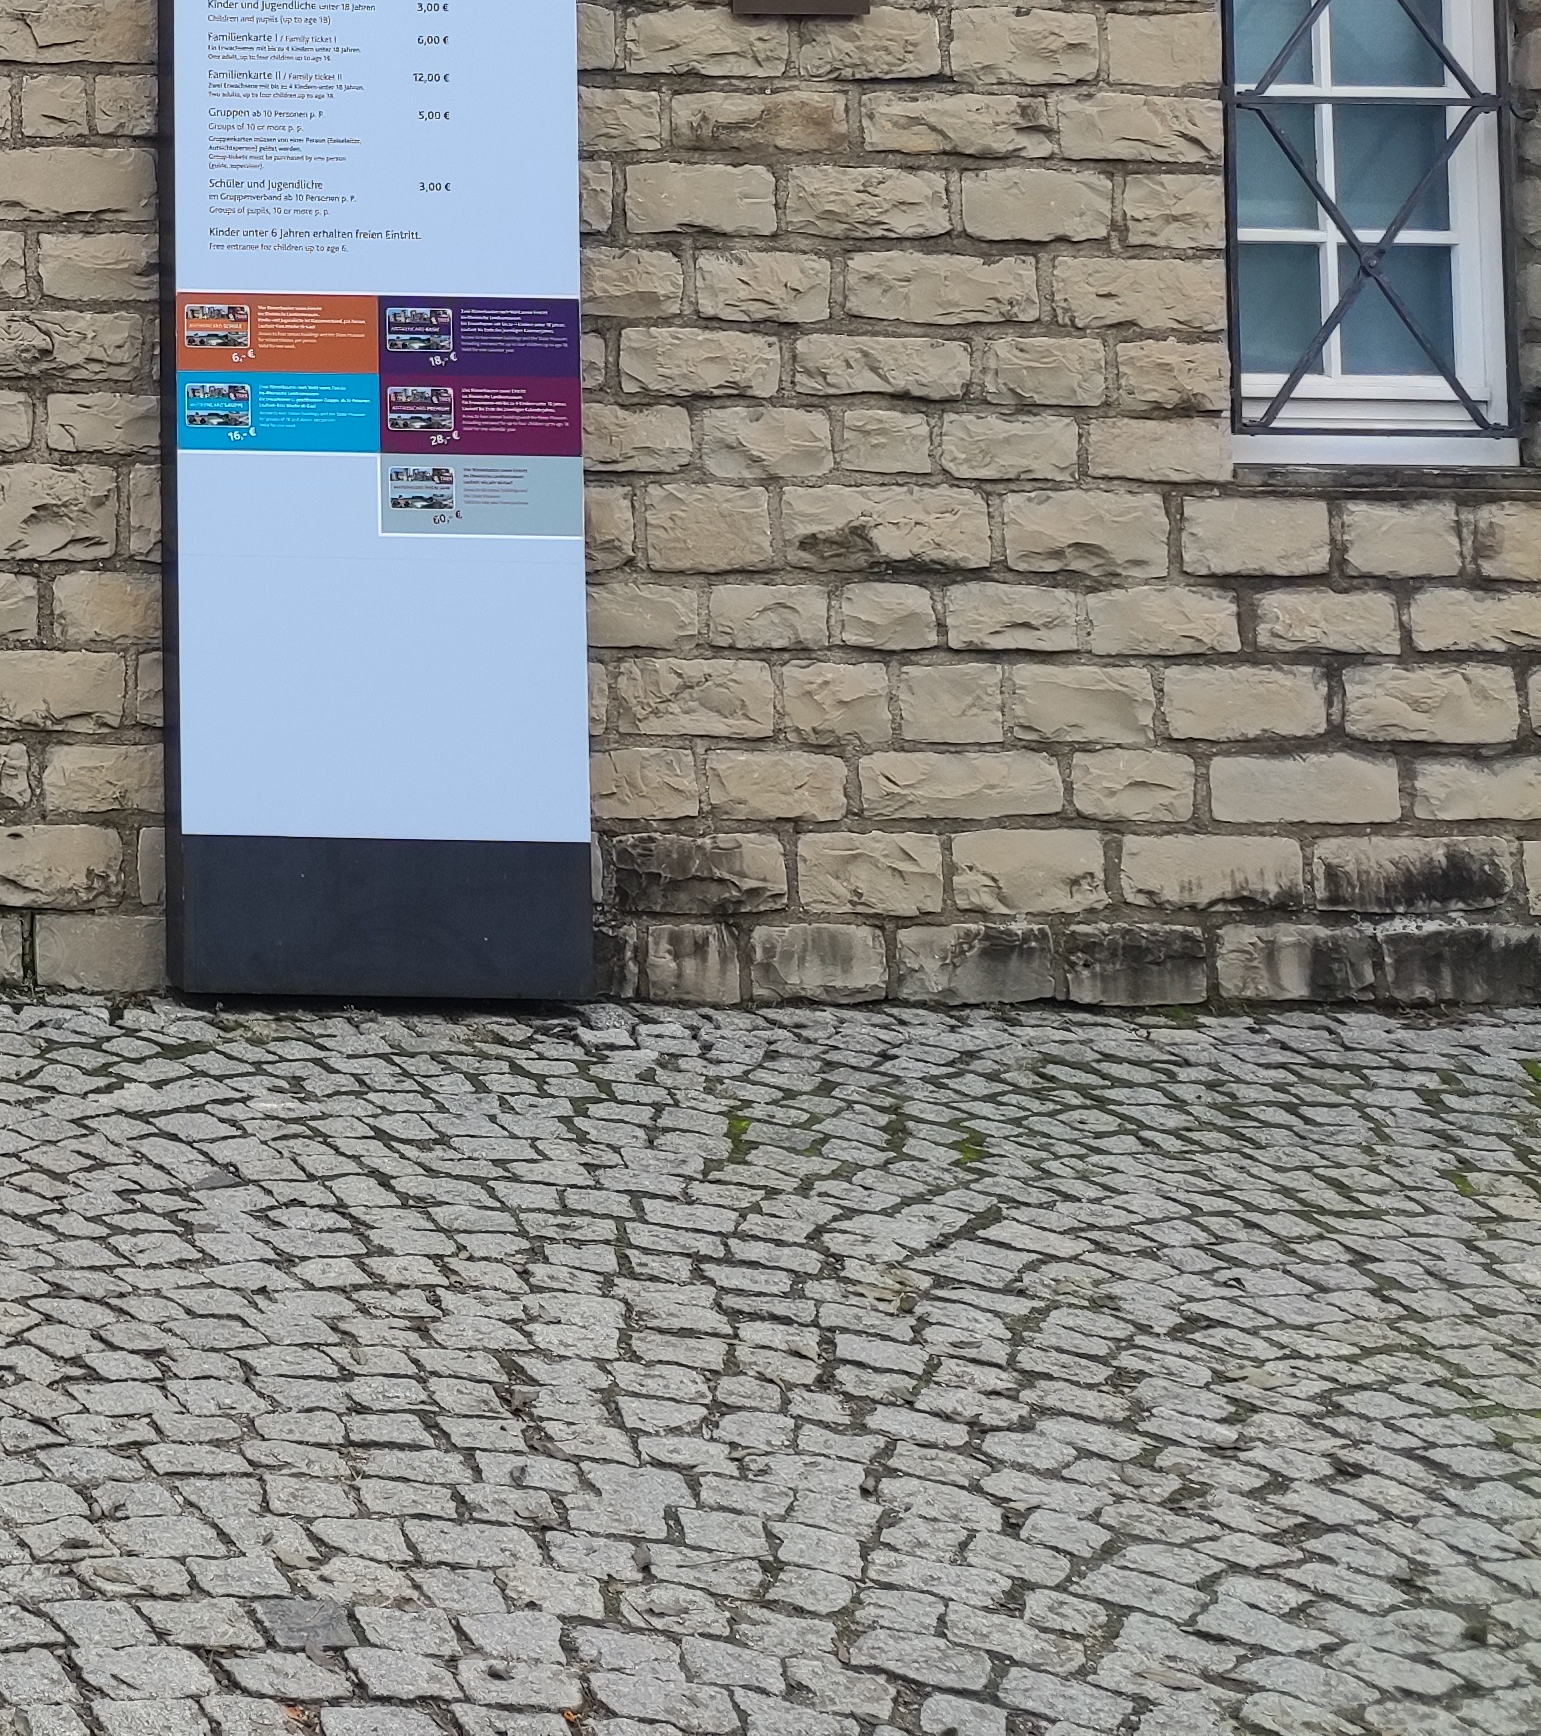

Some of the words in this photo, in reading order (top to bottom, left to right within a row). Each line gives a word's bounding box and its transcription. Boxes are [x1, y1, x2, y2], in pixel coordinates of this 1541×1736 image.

[207, 0, 239, 9] Kinder
[240, 0, 259, 9] und
[260, 0, 316, 12] Jugendliche
[416, 2, 440, 13] 3,00
[442, 3, 449, 12] €
[240, 15, 254, 23] and
[207, 32, 273, 42] Familienkarte
[208, 70, 273, 80] Familienkarte
[412, 73, 441, 84] 12,00
[443, 73, 450, 82] €
[208, 107, 250, 119] Gruppen
[263, 110, 273, 118] 10
[274, 110, 308, 118] Personen
[418, 110, 441, 121] 5,00
[443, 111, 450, 120] €
[209, 178, 244, 189] Schüler
[247, 179, 266, 189] und
[267, 179, 323, 191] Jugendliche
[419, 182, 442, 193] 3,00
[444, 182, 451, 192] €
[295, 194, 303, 202] 10
[305, 194, 340, 203] Personen
[209, 227, 240, 237] Kinder
[242, 228, 269, 238] unter
[271, 228, 278, 237] 6
[279, 228, 310, 239] Jahren
[312, 229, 353, 239] erhalten
[355, 229, 383, 240] freien
[273, 244, 304, 252] children
